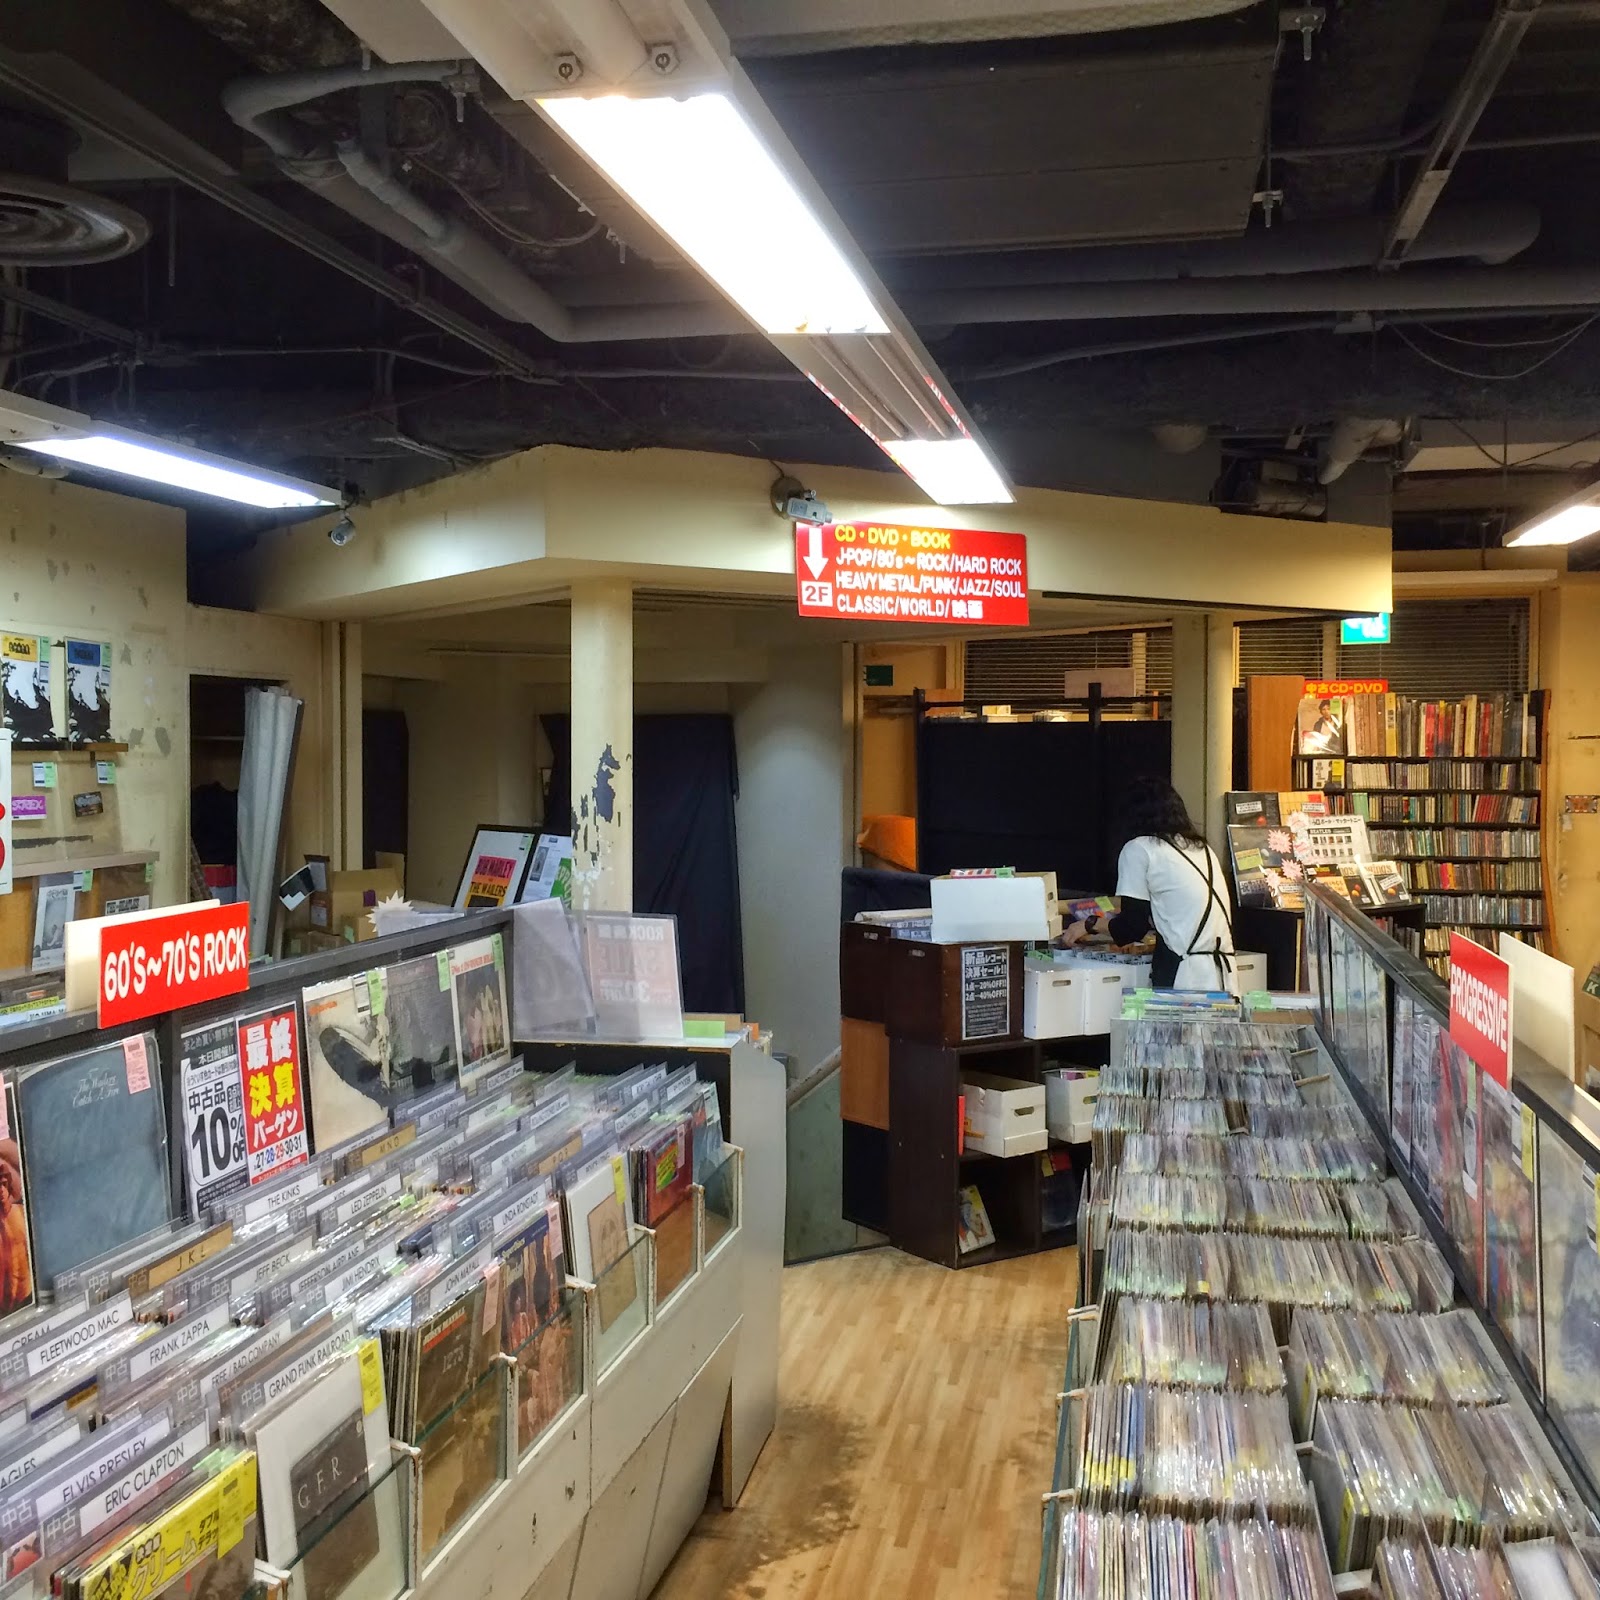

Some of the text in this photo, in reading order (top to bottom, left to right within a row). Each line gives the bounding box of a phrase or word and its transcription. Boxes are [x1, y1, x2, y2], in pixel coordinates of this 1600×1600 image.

[990, 558, 1022, 576] ROCK
[804, 585, 829, 602] 2F
[203, 925, 247, 977] ROCK
[1450, 963, 1507, 1053] PROGRESSIVE
[188, 1081, 226, 1115] 中古品
[253, 1108, 298, 1149] バーゲン
[267, 1193, 280, 1208] THE
[281, 1184, 300, 1203] KINKS
[351, 1199, 363, 1214] LED
[362, 1184, 387, 1208] ZEPPELIN
[502, 1208, 517, 1226] LINDA
[254, 1266, 271, 1284] JEFF
[271, 1253, 290, 1273] BECK
[354, 1255, 381, 1284] HENDRIX
[40, 1325, 96, 1364] FLEETWOOD
[97, 1310, 120, 1333] MAC
[150, 1338, 180, 1366] FRANK
[181, 1319, 210, 1347] ZAPPA
[232, 1359, 248, 1376] BAD
[248, 1333, 281, 1365] COMPANY
[269, 1363, 299, 1398] GRAND
[298, 1353, 317, 1375] FUNK
[317, 1329, 351, 1360] RAILROAD
[2, 1437, 147, 1530] 中古 ELVIS PRESLEY
[47, 1442, 185, 1540] 中古 ERIC CLAPTON
